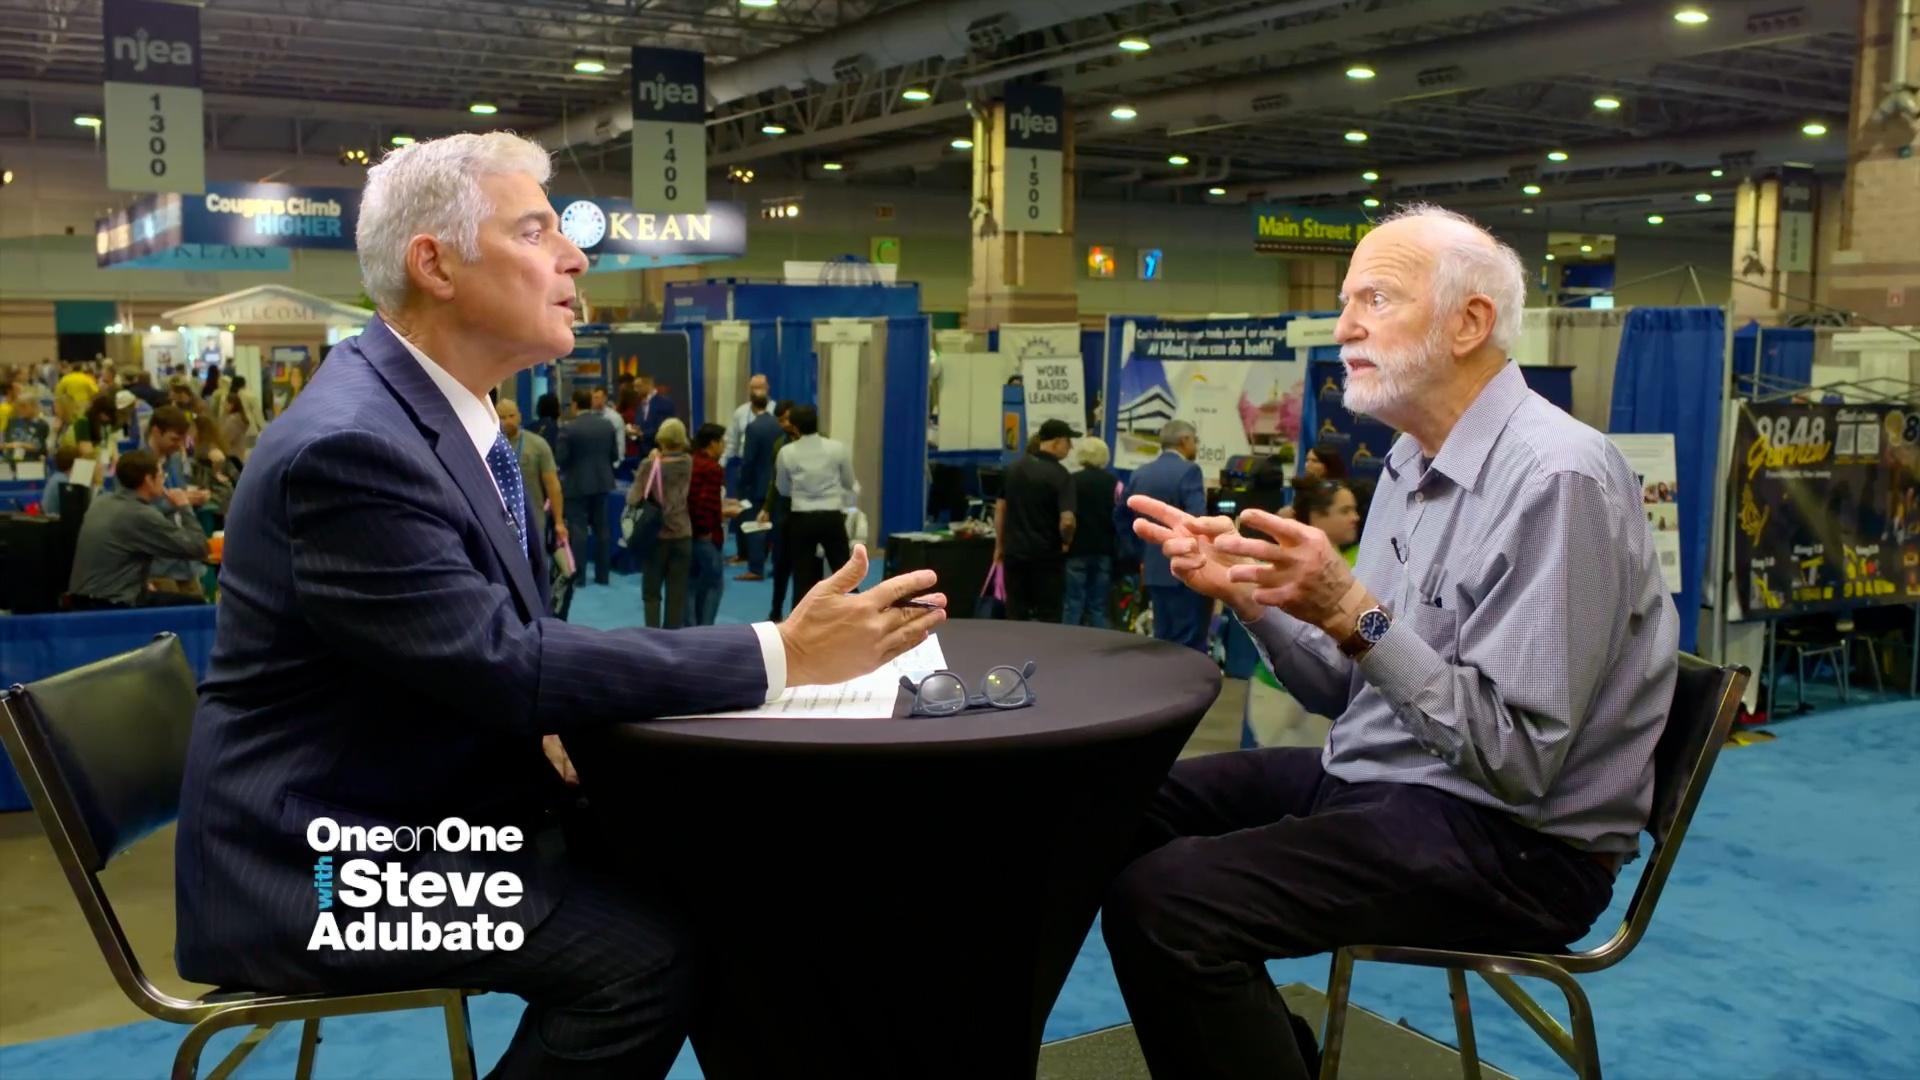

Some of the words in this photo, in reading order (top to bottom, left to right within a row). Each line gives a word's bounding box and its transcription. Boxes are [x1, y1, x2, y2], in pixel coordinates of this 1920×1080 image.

[113, 27, 193, 72] njea
[638, 72, 699, 111] njea
[149, 93, 166, 177] 1300
[1009, 106, 1058, 139] njea
[663, 128, 678, 201] 1400
[1028, 154, 1040, 220] 1500
[287, 198, 341, 218] Climb
[255, 216, 341, 237] HIGHER
[608, 212, 713, 241] KEAN
[1258, 215, 1299, 237] Main
[1303, 218, 1351, 240] Street
[1036, 366, 1068, 377] WORK
[1036, 379, 1070, 391] BASED
[1028, 392, 1079, 405] LEARNING
